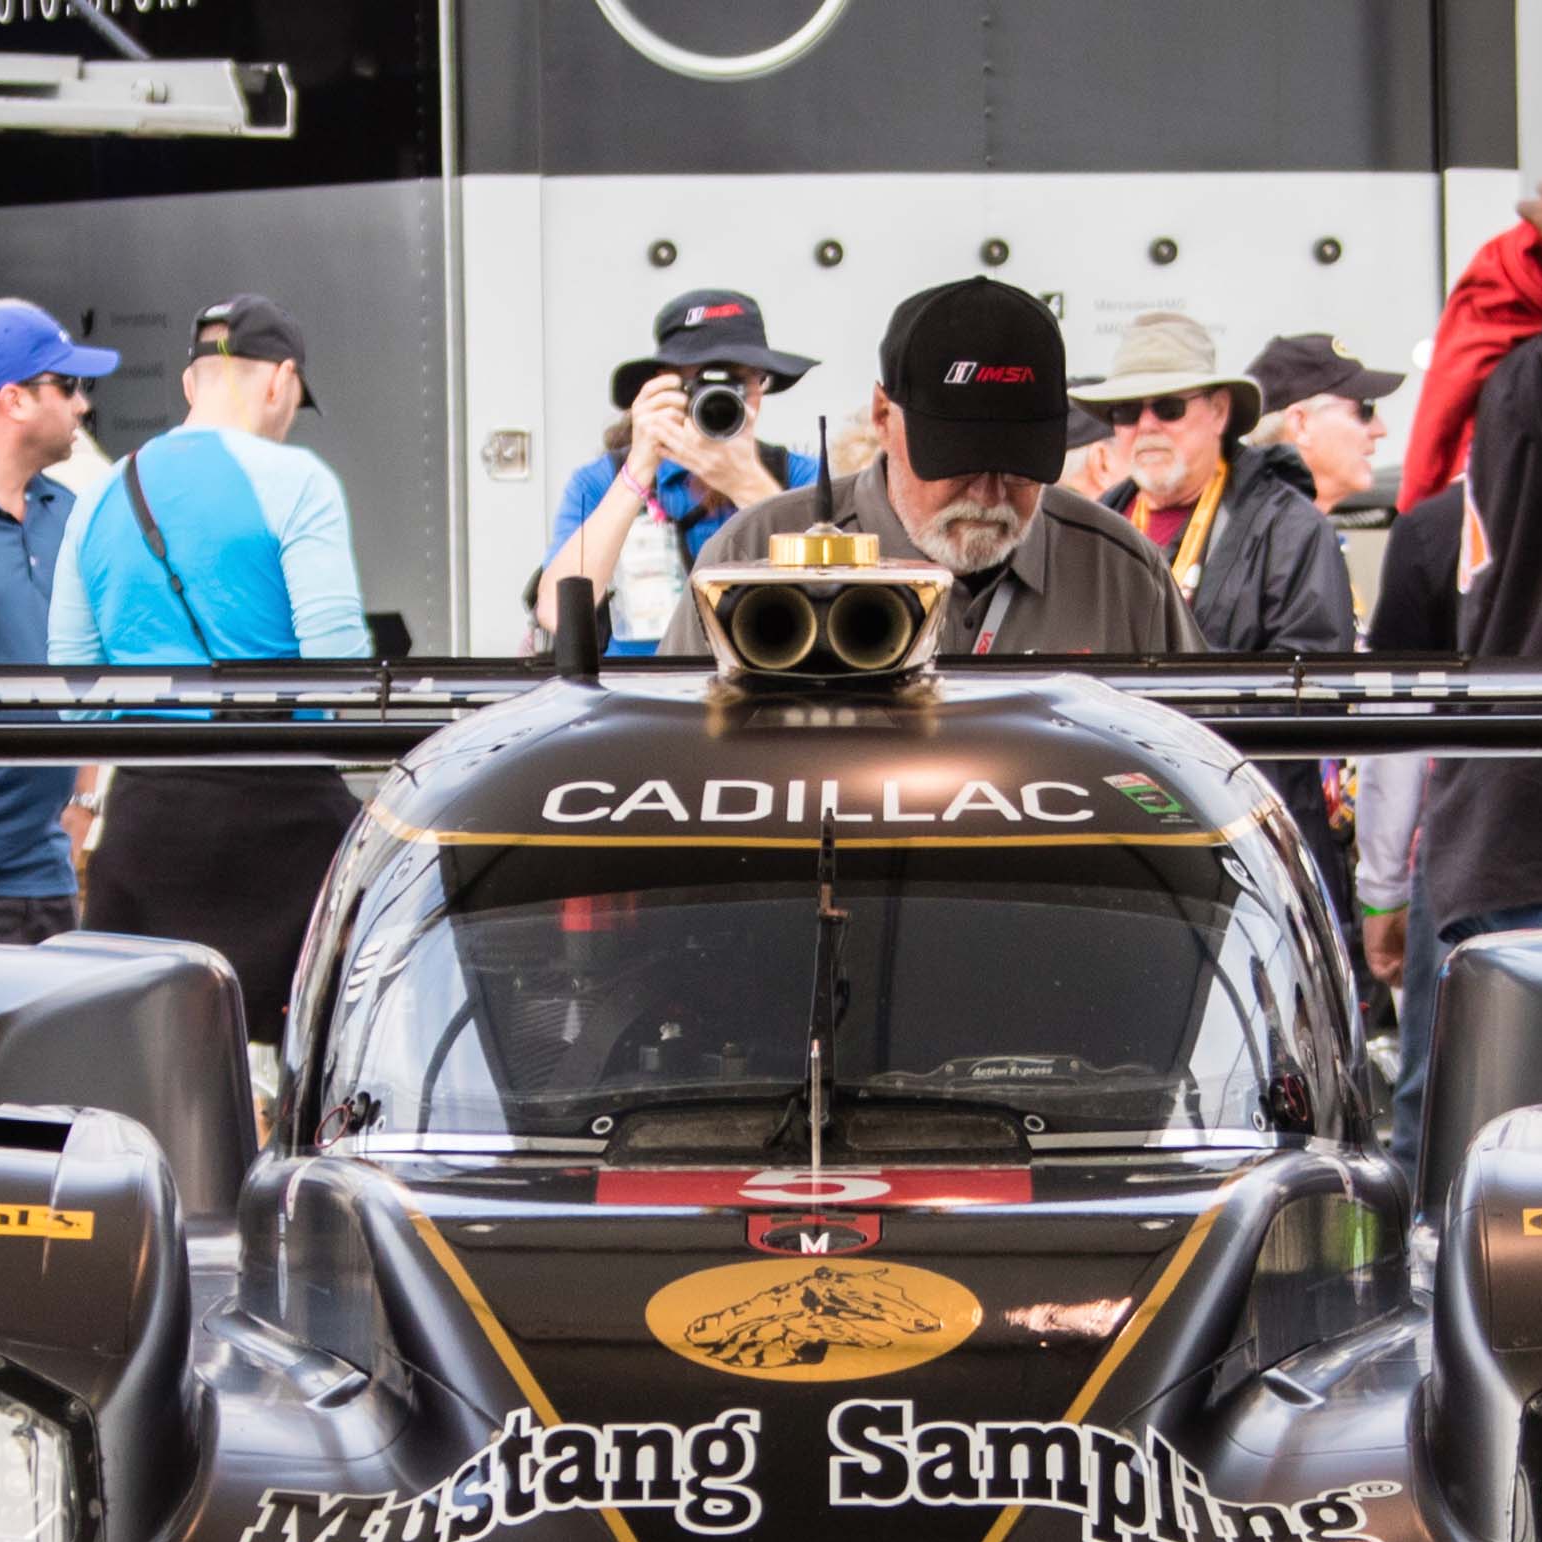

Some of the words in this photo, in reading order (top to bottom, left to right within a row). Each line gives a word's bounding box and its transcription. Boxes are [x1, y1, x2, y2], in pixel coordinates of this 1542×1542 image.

[974, 365, 1036, 384] IMSA
[542, 780, 1095, 823] CADILLAC
[737, 1168, 892, 1204] 5
[799, 1231, 830, 1254] M
